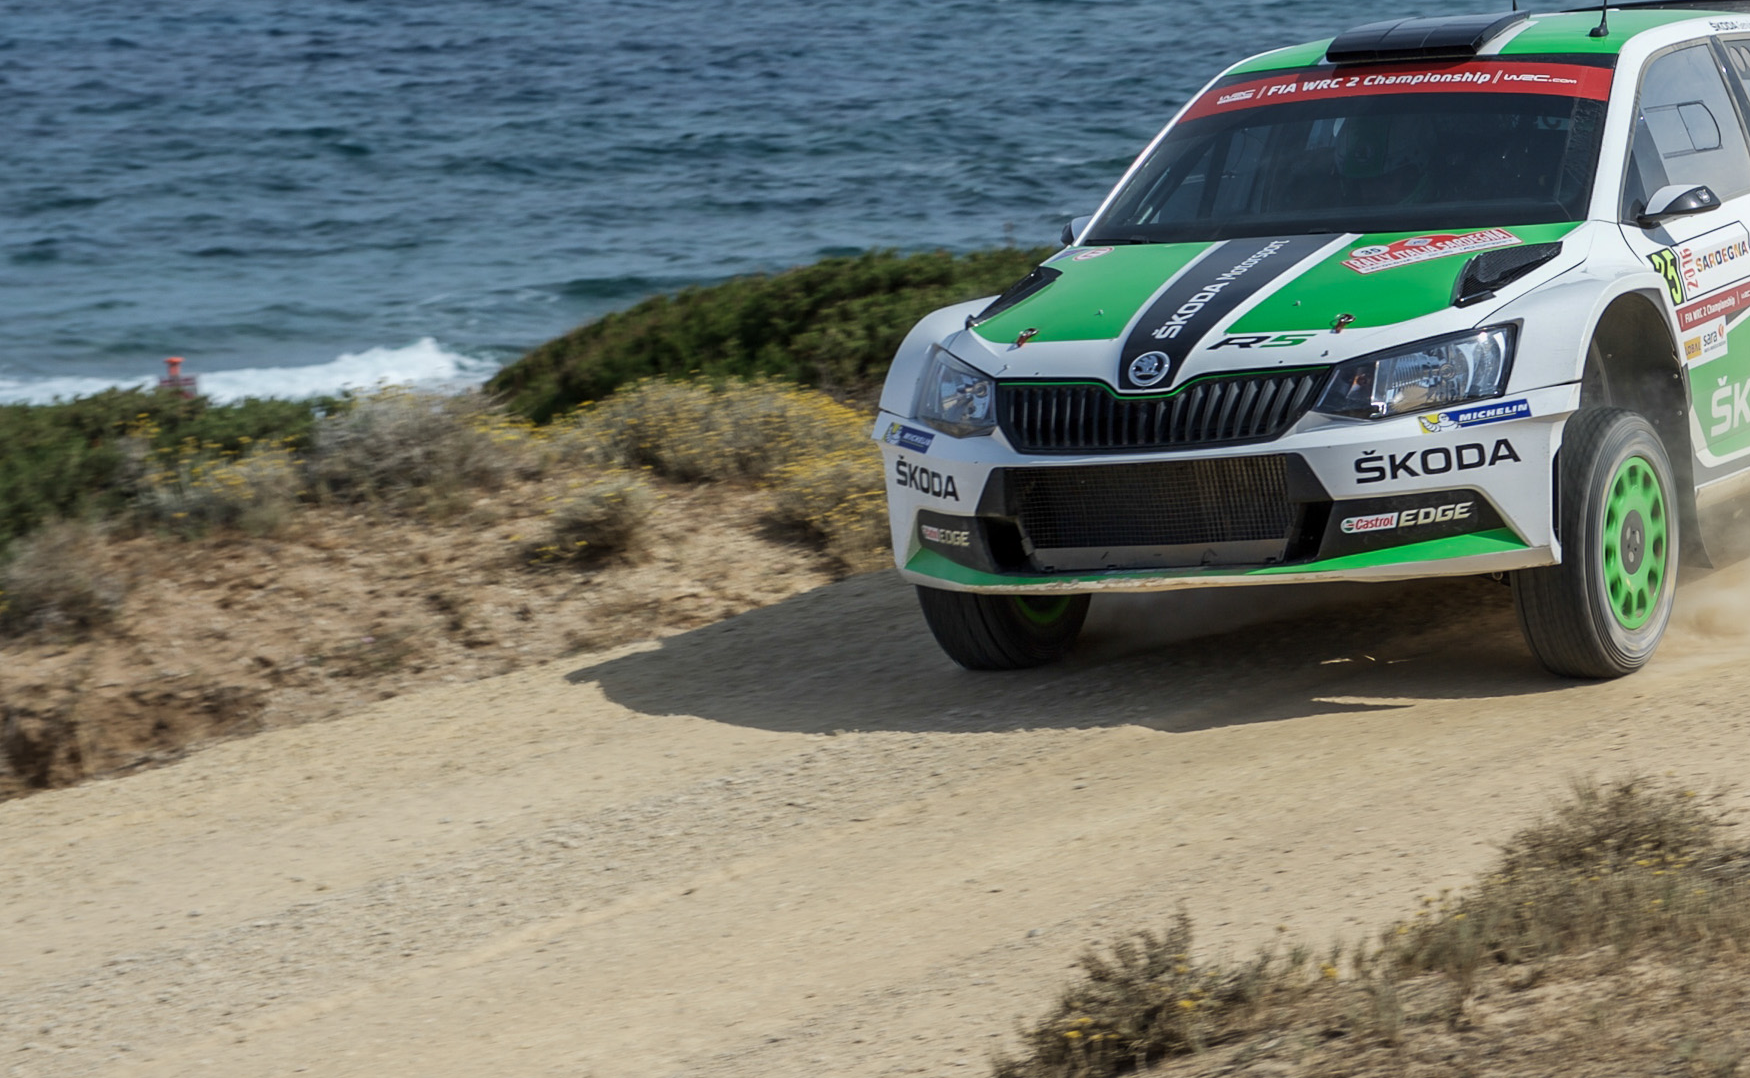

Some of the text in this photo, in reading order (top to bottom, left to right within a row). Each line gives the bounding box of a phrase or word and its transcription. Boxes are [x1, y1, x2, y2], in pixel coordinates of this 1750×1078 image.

[1267, 83, 1296, 96] FIA
[1302, 78, 1343, 91] WRC
[1346, 77, 1359, 87] 2
[1363, 71, 1491, 86] Championship
[1353, 253, 1396, 269] RALLY
[1394, 245, 1435, 260] ITALIA
[1436, 229, 1508, 250] SARDEGNA
[1360, 247, 1382, 256] 35
[1695, 241, 1749, 273] SARDEGNA
[1152, 240, 1290, 339] ŠKODA Motorsport
[1651, 249, 1682, 304] 35
[1703, 331, 1718, 347] sara
[1459, 403, 1528, 422] MICHELIN
[1354, 438, 1522, 484] ŠKODA
[896, 454, 960, 502] ŠKODA
[1355, 501, 1474, 530] Castrol EDGE
[939, 529, 970, 547] EDGE
